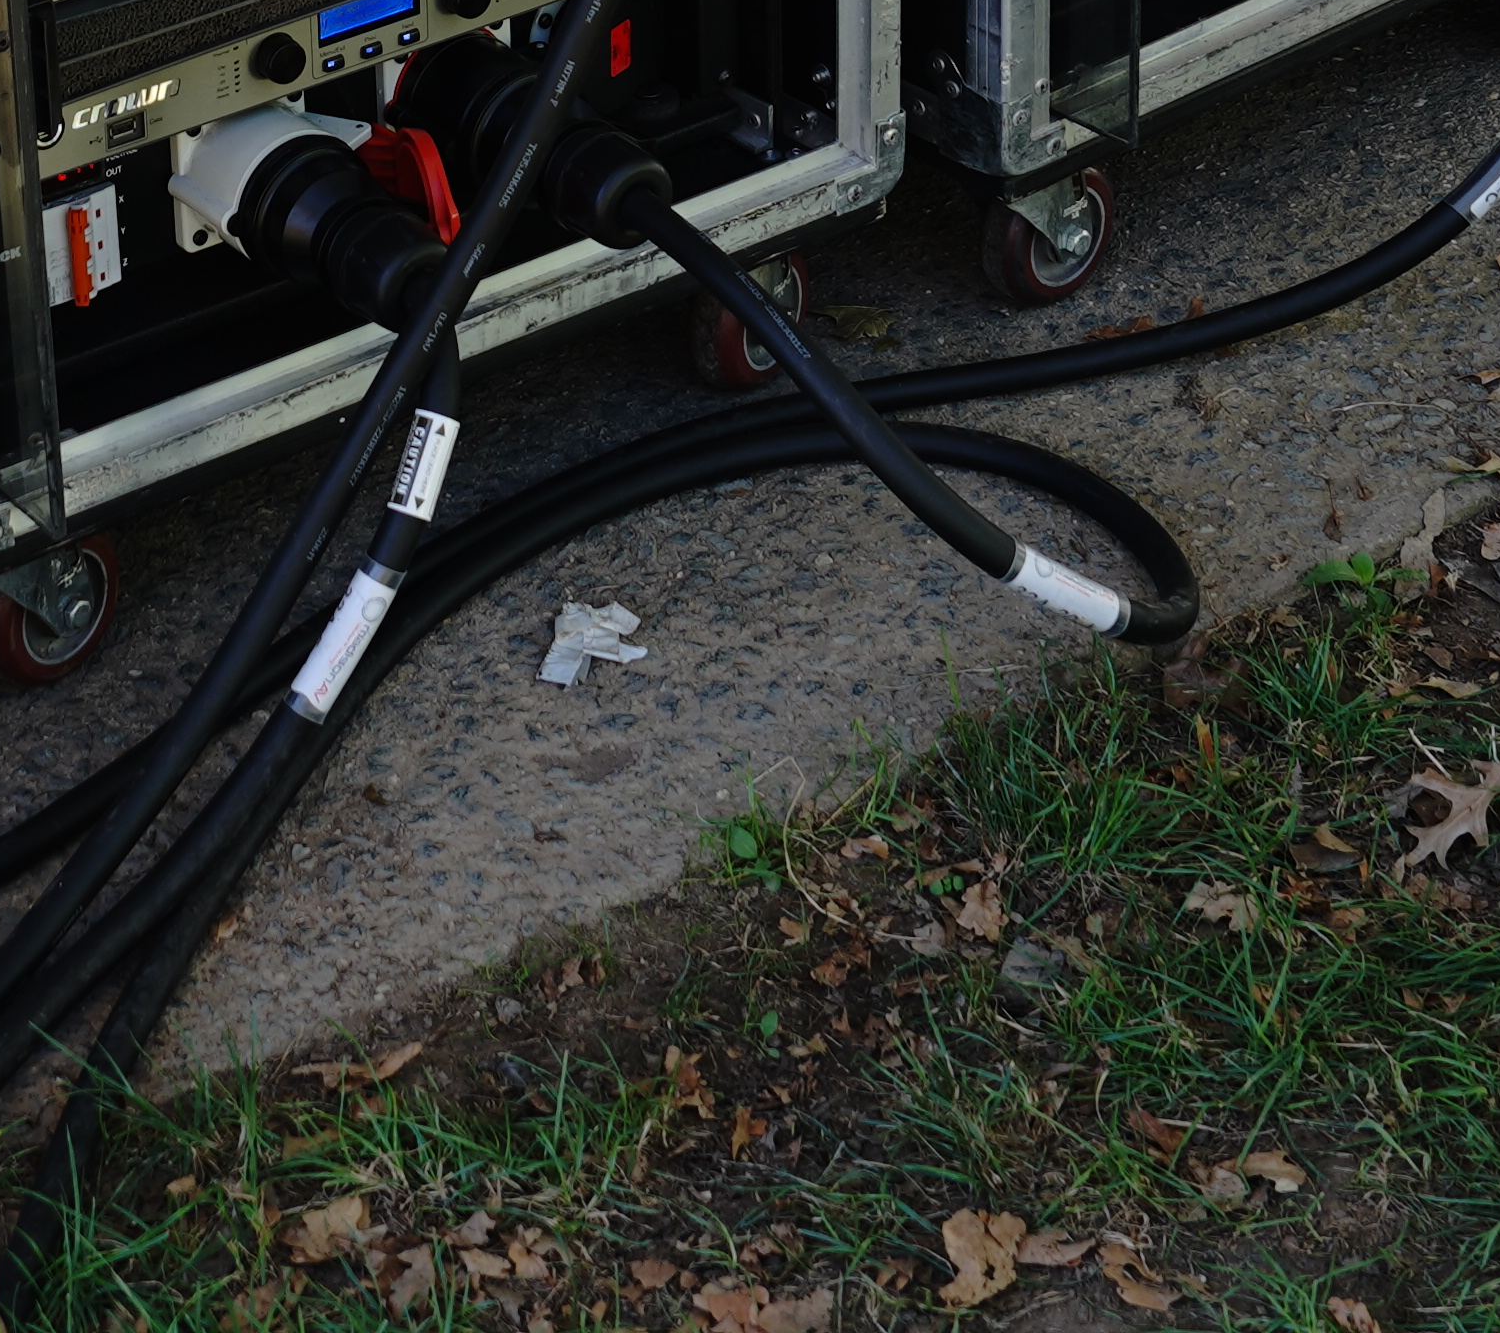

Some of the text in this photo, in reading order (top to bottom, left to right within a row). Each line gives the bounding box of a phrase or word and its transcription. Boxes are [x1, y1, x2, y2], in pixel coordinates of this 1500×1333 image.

[72, 78, 181, 129] crown
[106, 165, 122, 178] OUT
[119, 195, 125, 204] X
[121, 226, 126, 235] Y
[123, 257, 129, 267] Z
[397, 426, 427, 495] CAUTION
